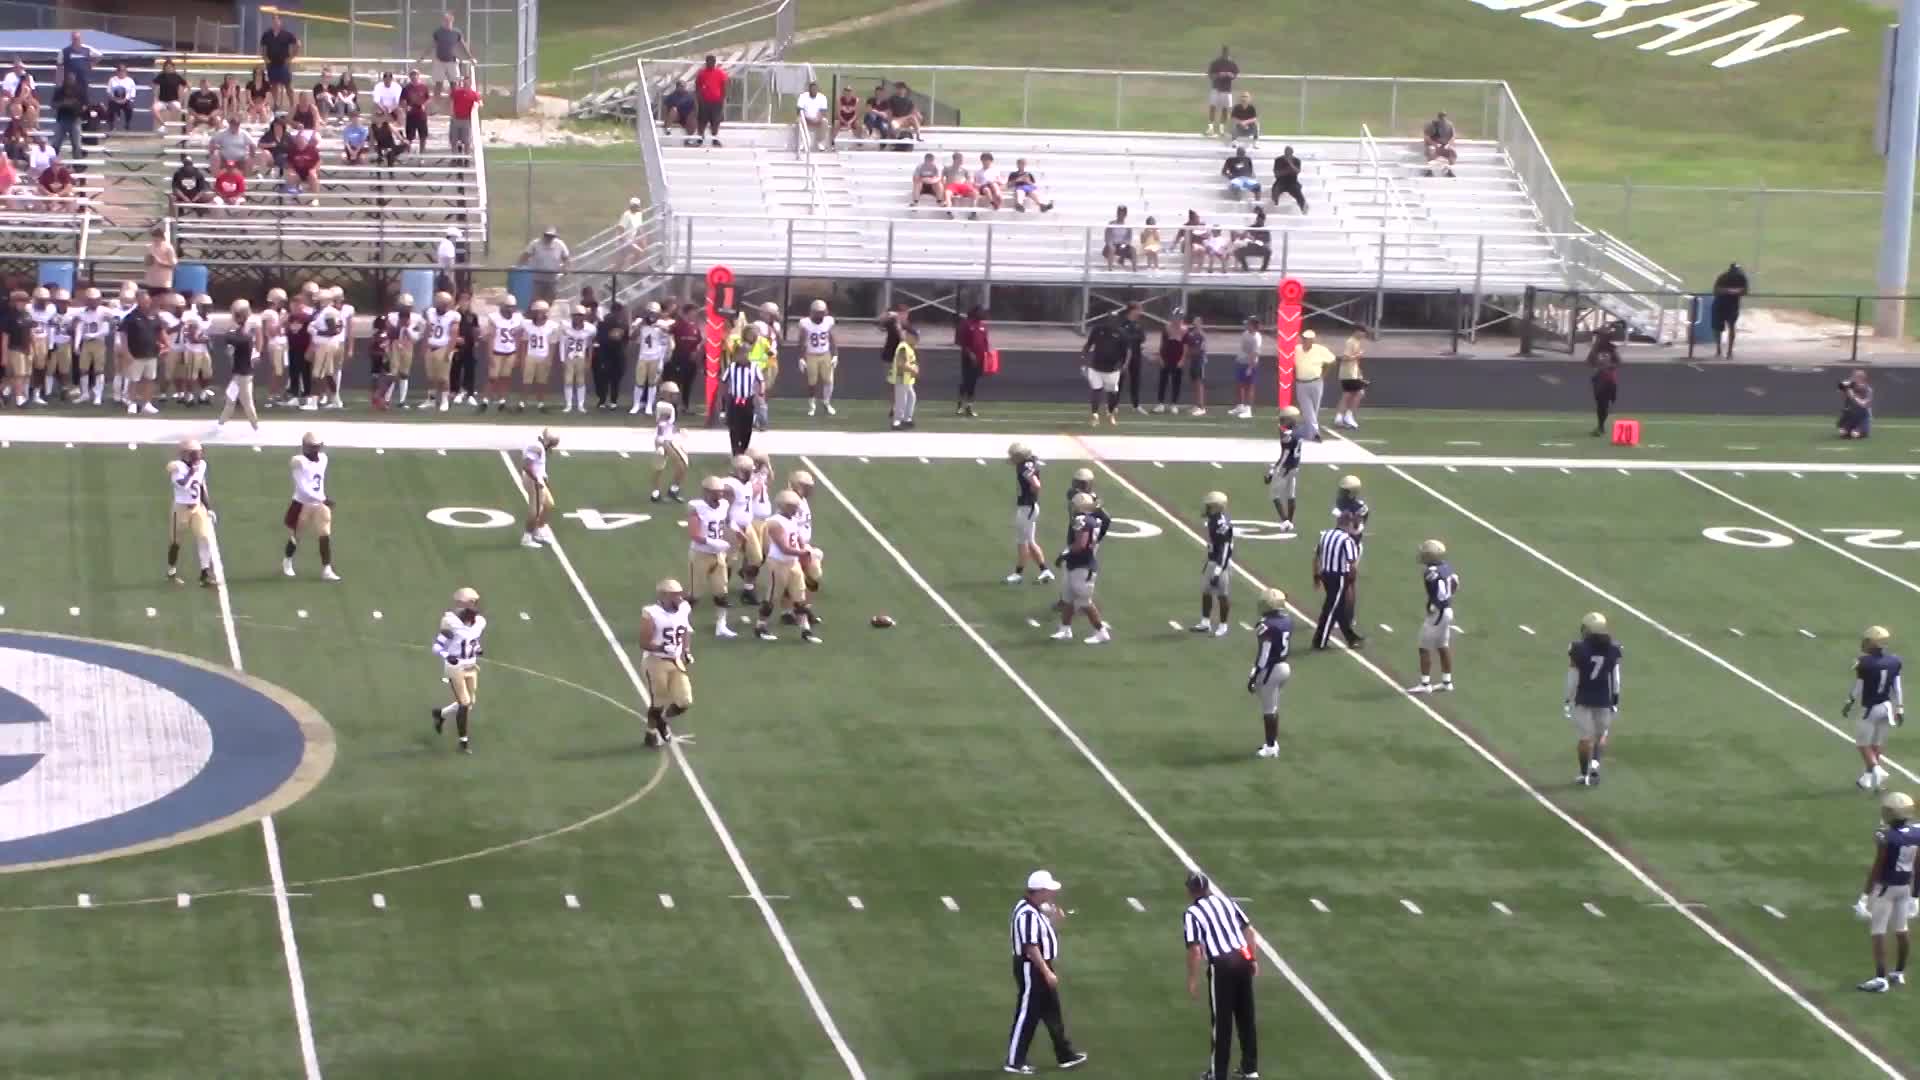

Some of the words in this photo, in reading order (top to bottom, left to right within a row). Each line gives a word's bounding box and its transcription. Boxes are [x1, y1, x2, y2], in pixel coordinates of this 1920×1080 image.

[1617, 423, 1633, 443] 20
[312, 473, 321, 491] 3
[1591, 654, 1603, 681] 7
[1877, 669, 1887, 694] 1
